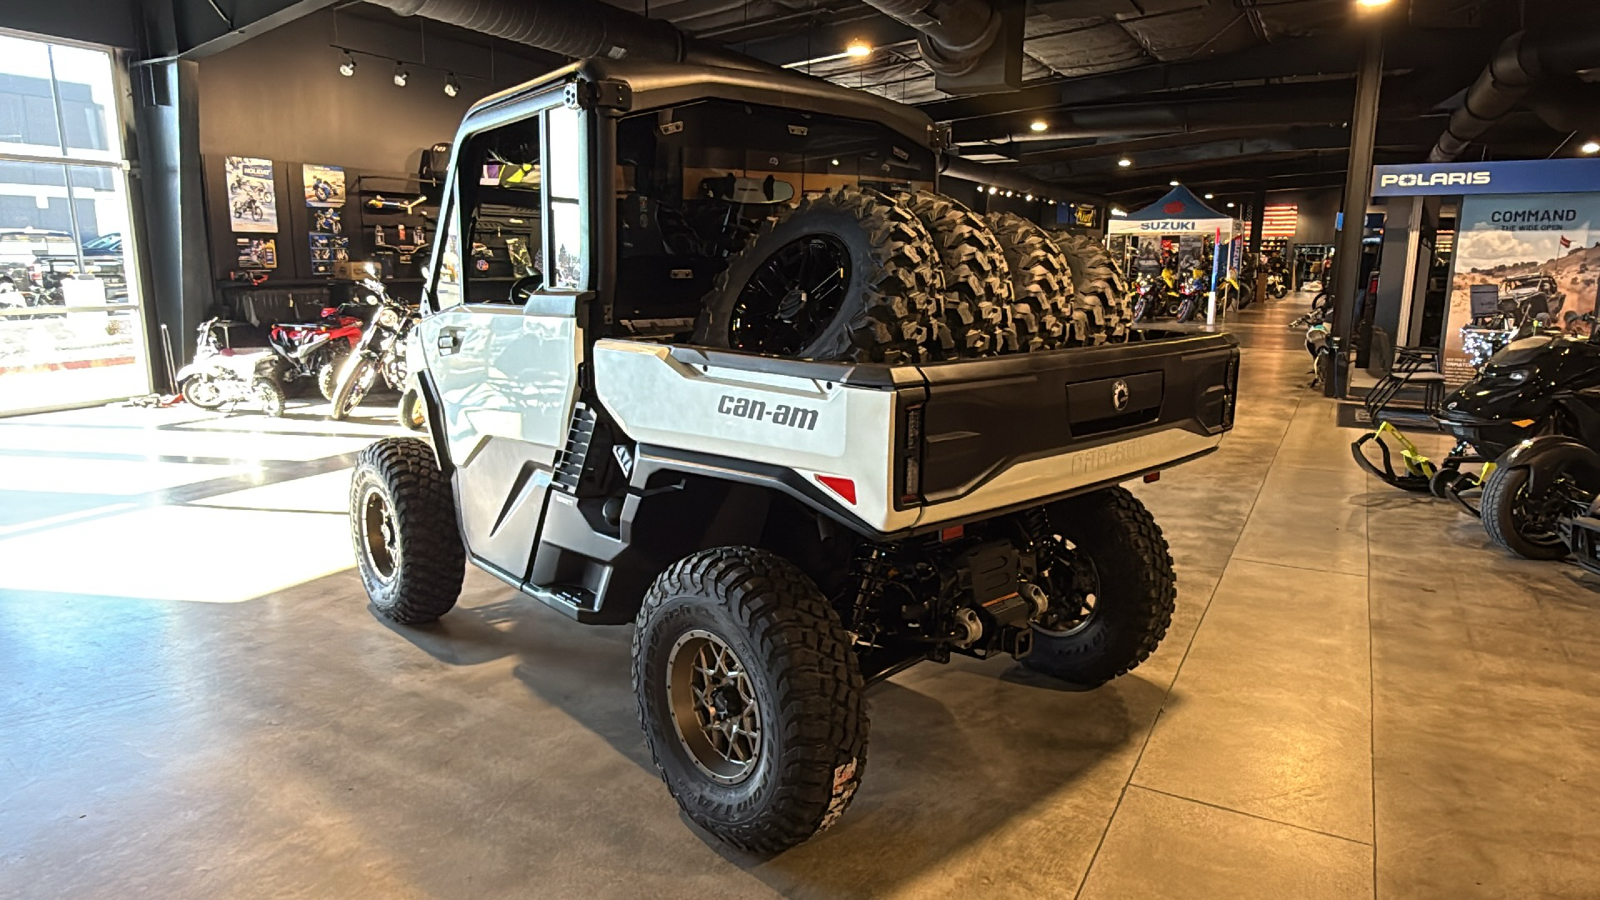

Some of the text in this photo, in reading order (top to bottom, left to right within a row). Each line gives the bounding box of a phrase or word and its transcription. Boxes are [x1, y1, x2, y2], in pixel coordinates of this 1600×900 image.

[1381, 171, 1491, 188] POLARIS
[1491, 209, 1577, 223] COMMAND
[1140, 221, 1196, 231] SUZUKI
[1501, 224, 1516, 232] THE
[1518, 224, 1539, 232] WIDE
[1232, 239, 1242, 269] SUZUK
[717, 394, 819, 431] can-am
